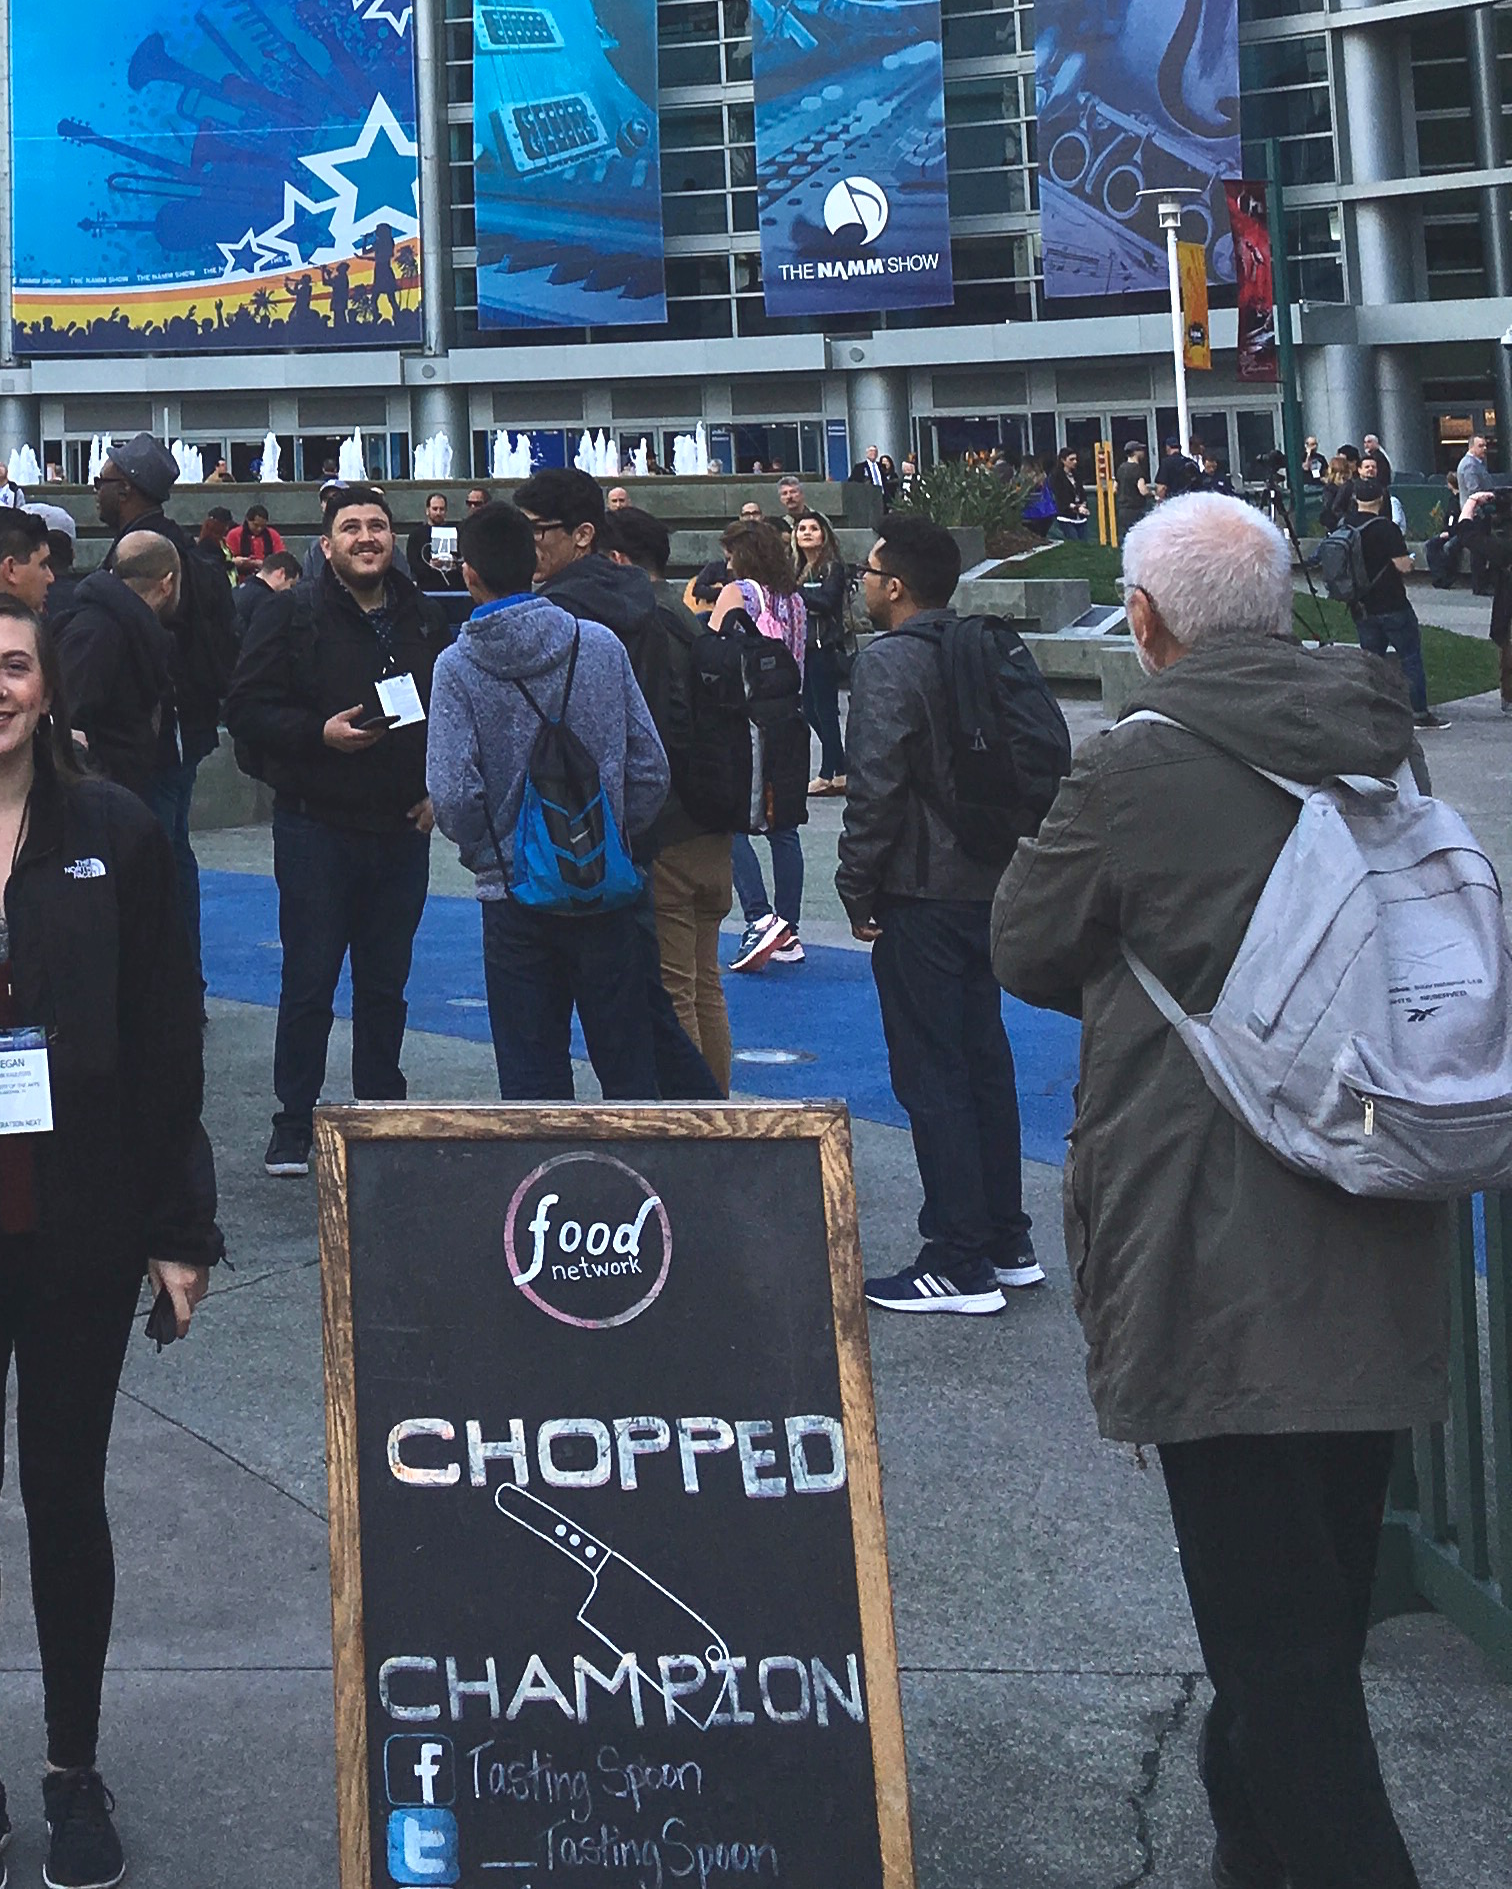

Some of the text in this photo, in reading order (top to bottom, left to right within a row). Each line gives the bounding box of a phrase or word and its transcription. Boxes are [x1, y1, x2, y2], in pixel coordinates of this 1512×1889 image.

[778, 253, 939, 281] THE NAMM SHOW
[514, 1194, 663, 1286] food
[551, 1256, 643, 1282] network
[385, 1414, 849, 1499] CHOPPED
[377, 1651, 867, 1728] CHAMPION
[466, 1739, 590, 1823] Tasting
[596, 1744, 703, 1812] Spoon
